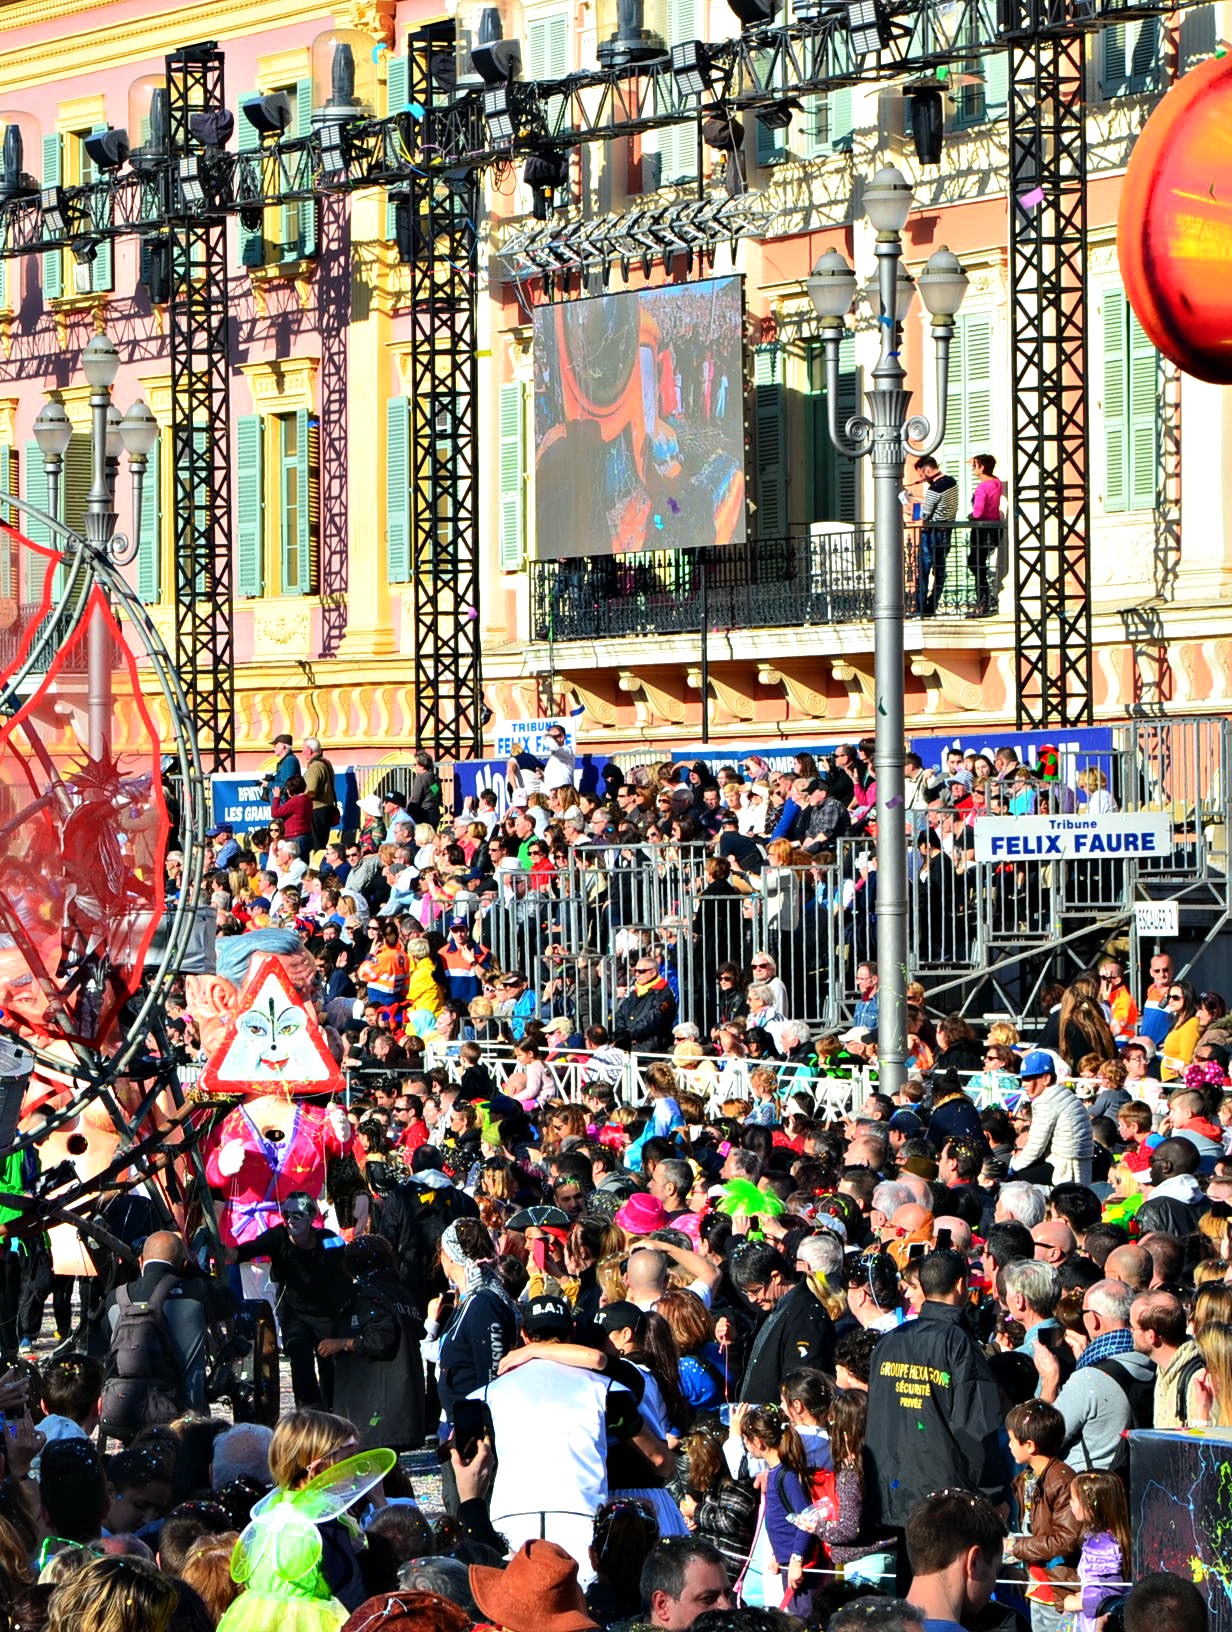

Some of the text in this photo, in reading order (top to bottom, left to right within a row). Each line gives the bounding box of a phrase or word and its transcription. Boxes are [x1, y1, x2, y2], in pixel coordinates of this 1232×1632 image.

[225, 807, 243, 822] LES
[1049, 820, 1097, 830] Tribune
[991, 832, 1156, 856] FELIX FAURE
[880, 1361, 909, 1378] GROUPE
[895, 1380, 931, 1397] SÉCURITÉ
